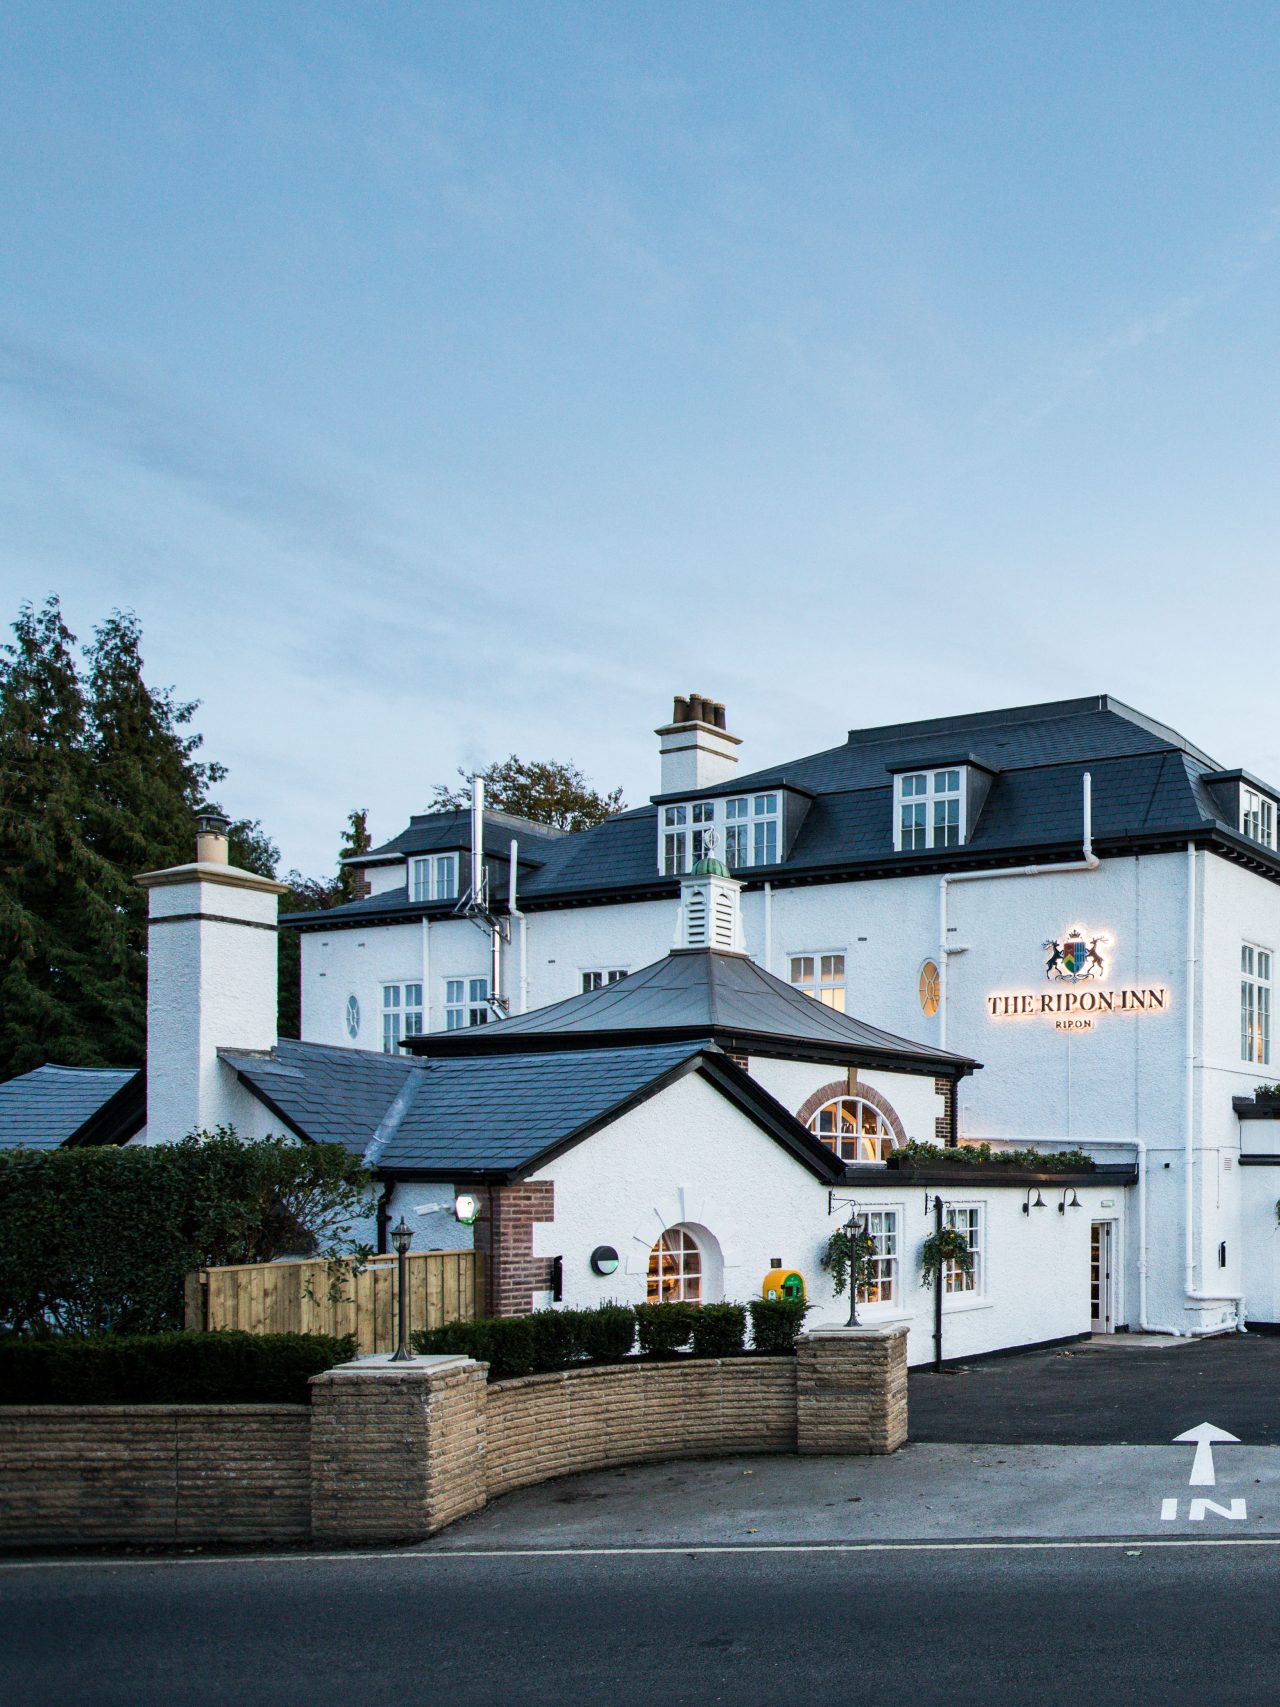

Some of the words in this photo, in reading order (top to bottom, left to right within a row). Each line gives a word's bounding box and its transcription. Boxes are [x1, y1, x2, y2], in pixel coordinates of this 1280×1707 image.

[988, 995, 1034, 1014] THE
[1041, 990, 1115, 1012] RIPON
[1121, 988, 1165, 1008] INN
[1055, 1019, 1091, 1029] RIPON
[1160, 1498, 1248, 1520] IN
